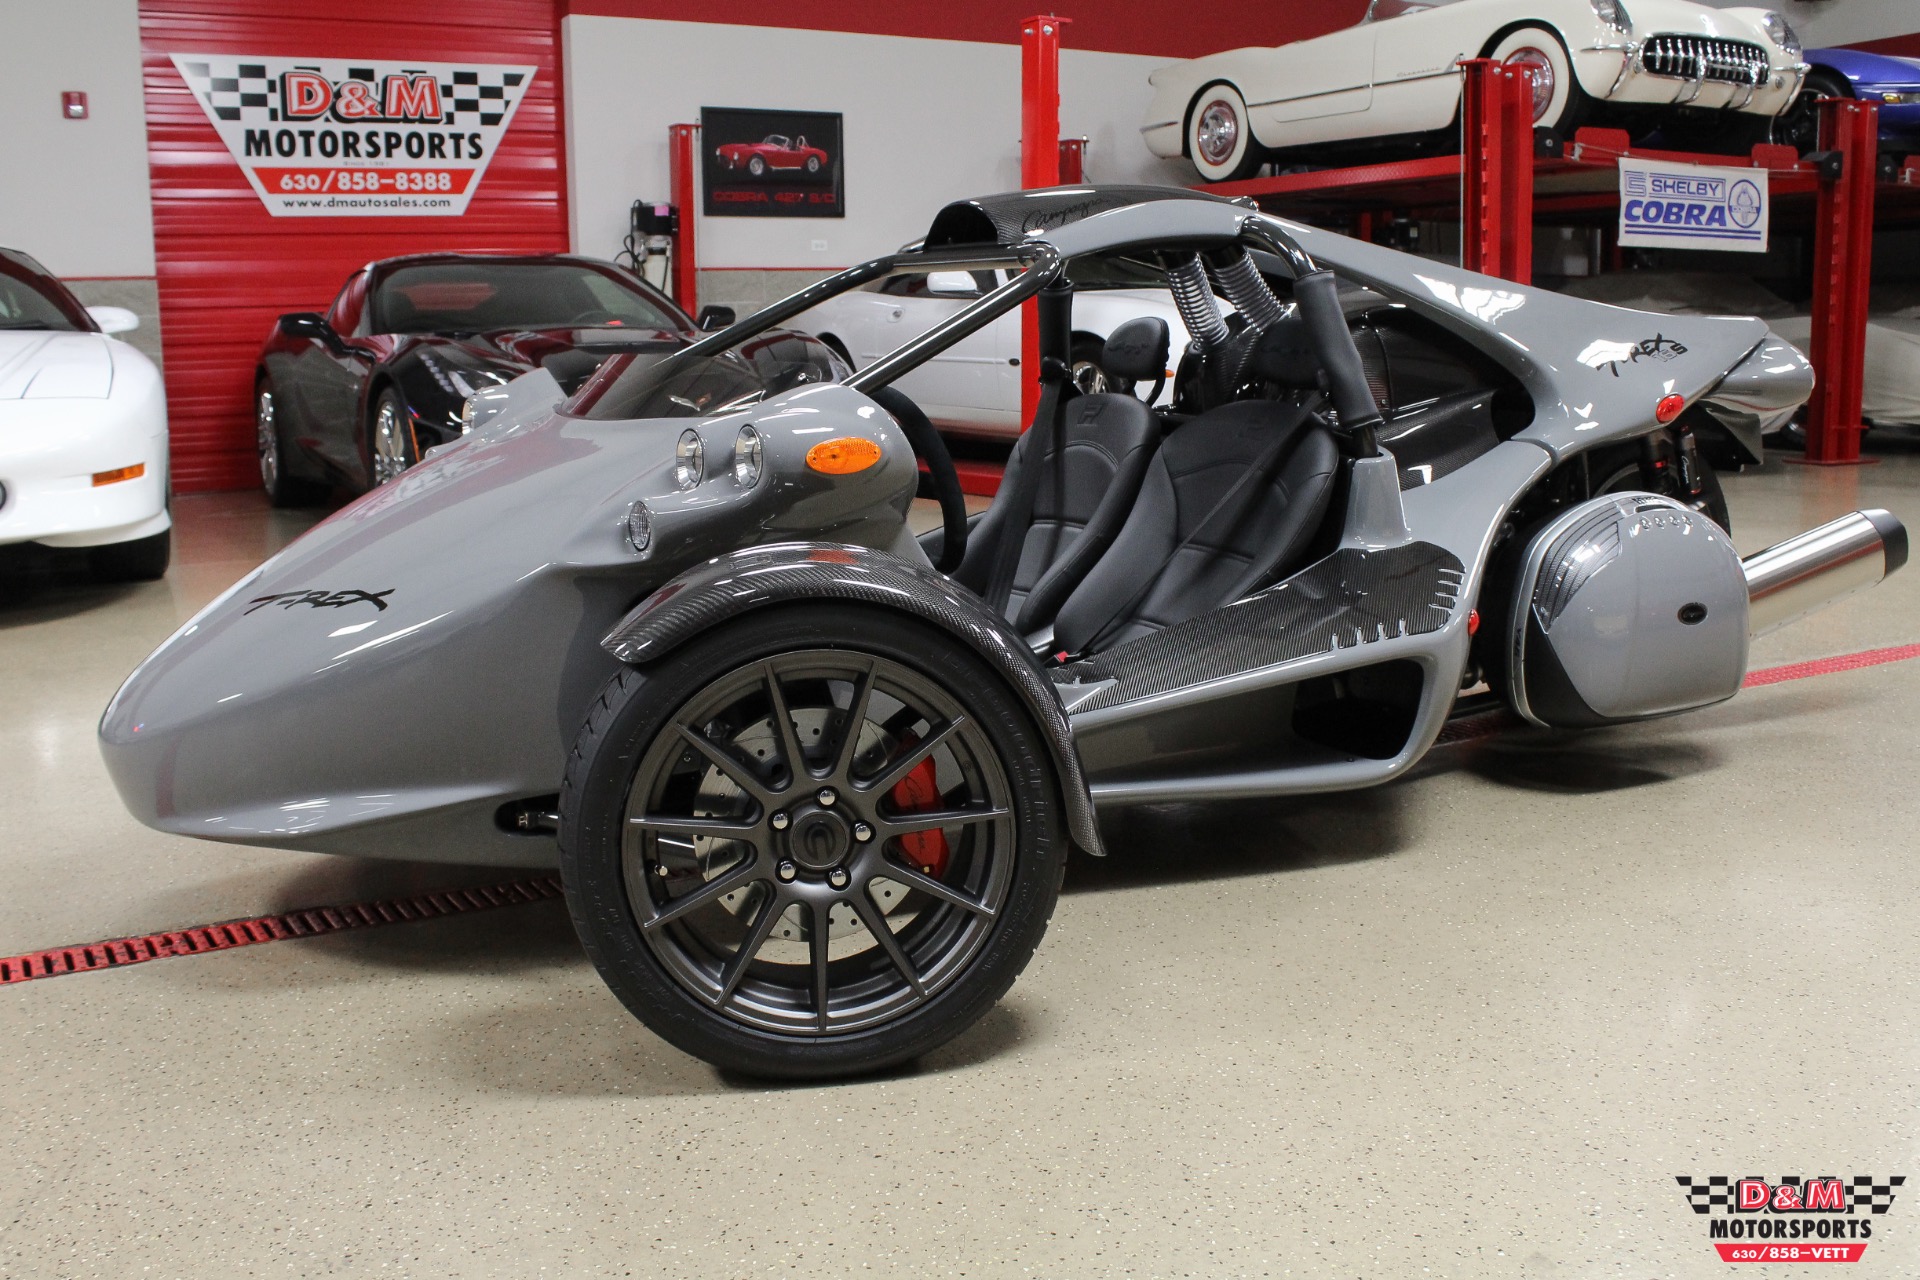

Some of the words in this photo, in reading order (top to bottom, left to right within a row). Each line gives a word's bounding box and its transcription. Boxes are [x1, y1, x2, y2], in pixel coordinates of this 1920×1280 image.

[281, 72, 442, 123] D&M
[245, 129, 483, 159] MOTORSPORTS
[280, 170, 452, 192] 630/858-8388
[1651, 179, 1719, 196] SHELBY
[283, 197, 450, 208] www.dmautosales.com
[1624, 200, 1727, 226] COBRA
[243, 588, 396, 616] T-REX
